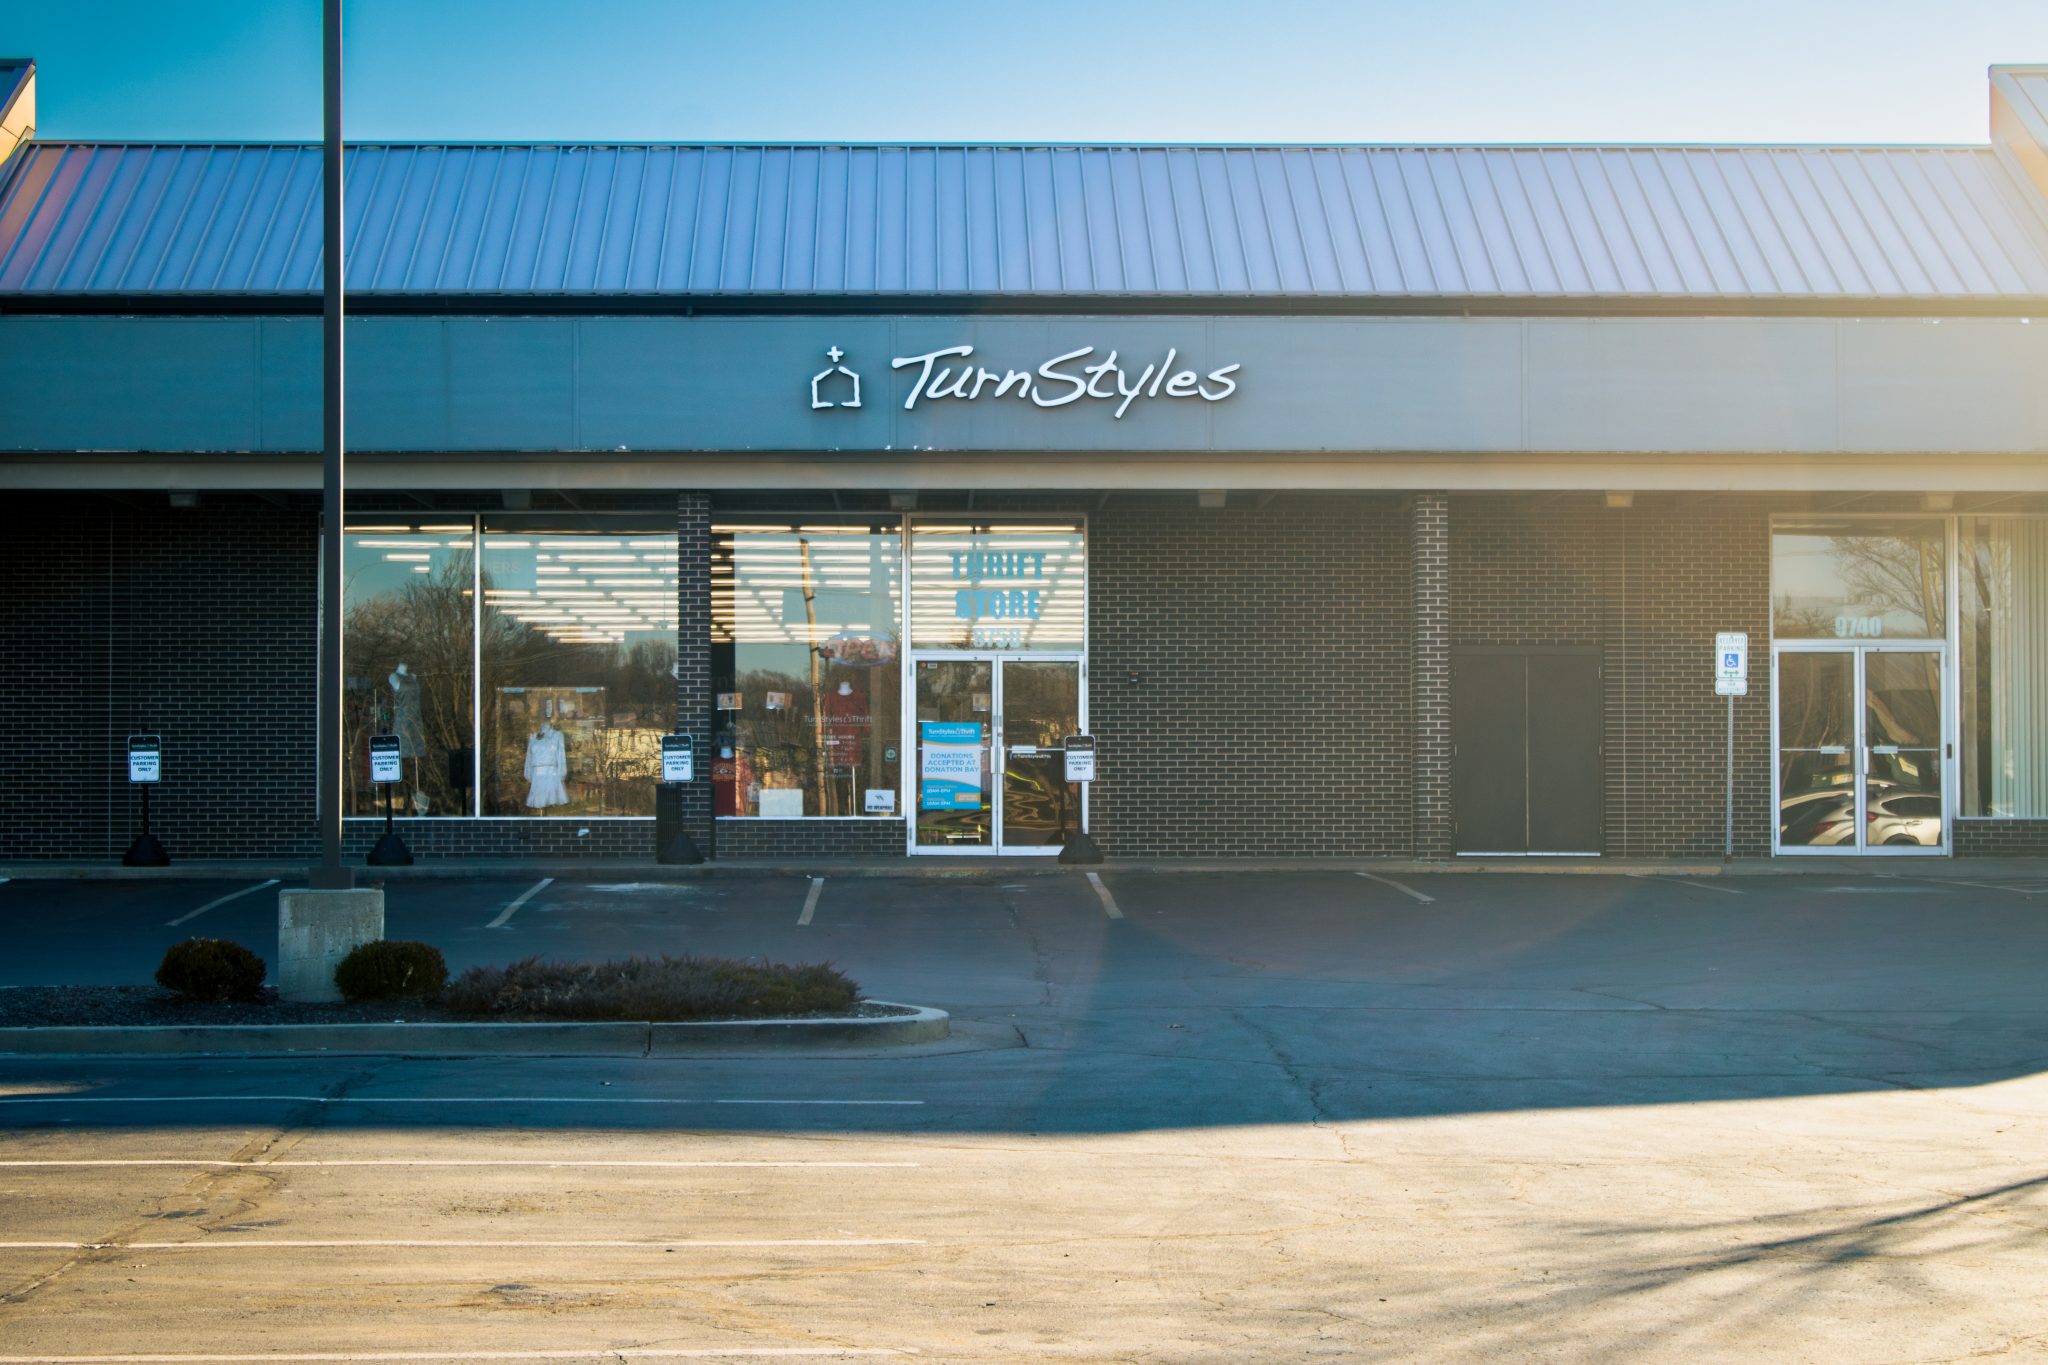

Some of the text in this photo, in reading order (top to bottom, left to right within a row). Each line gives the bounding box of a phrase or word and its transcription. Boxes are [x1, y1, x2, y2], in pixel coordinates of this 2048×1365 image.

[891, 345, 1241, 419] TurnStyles
[949, 552, 1046, 581] THRIFT
[955, 591, 1041, 619] STORE
[1834, 615, 1882, 637] 9740
